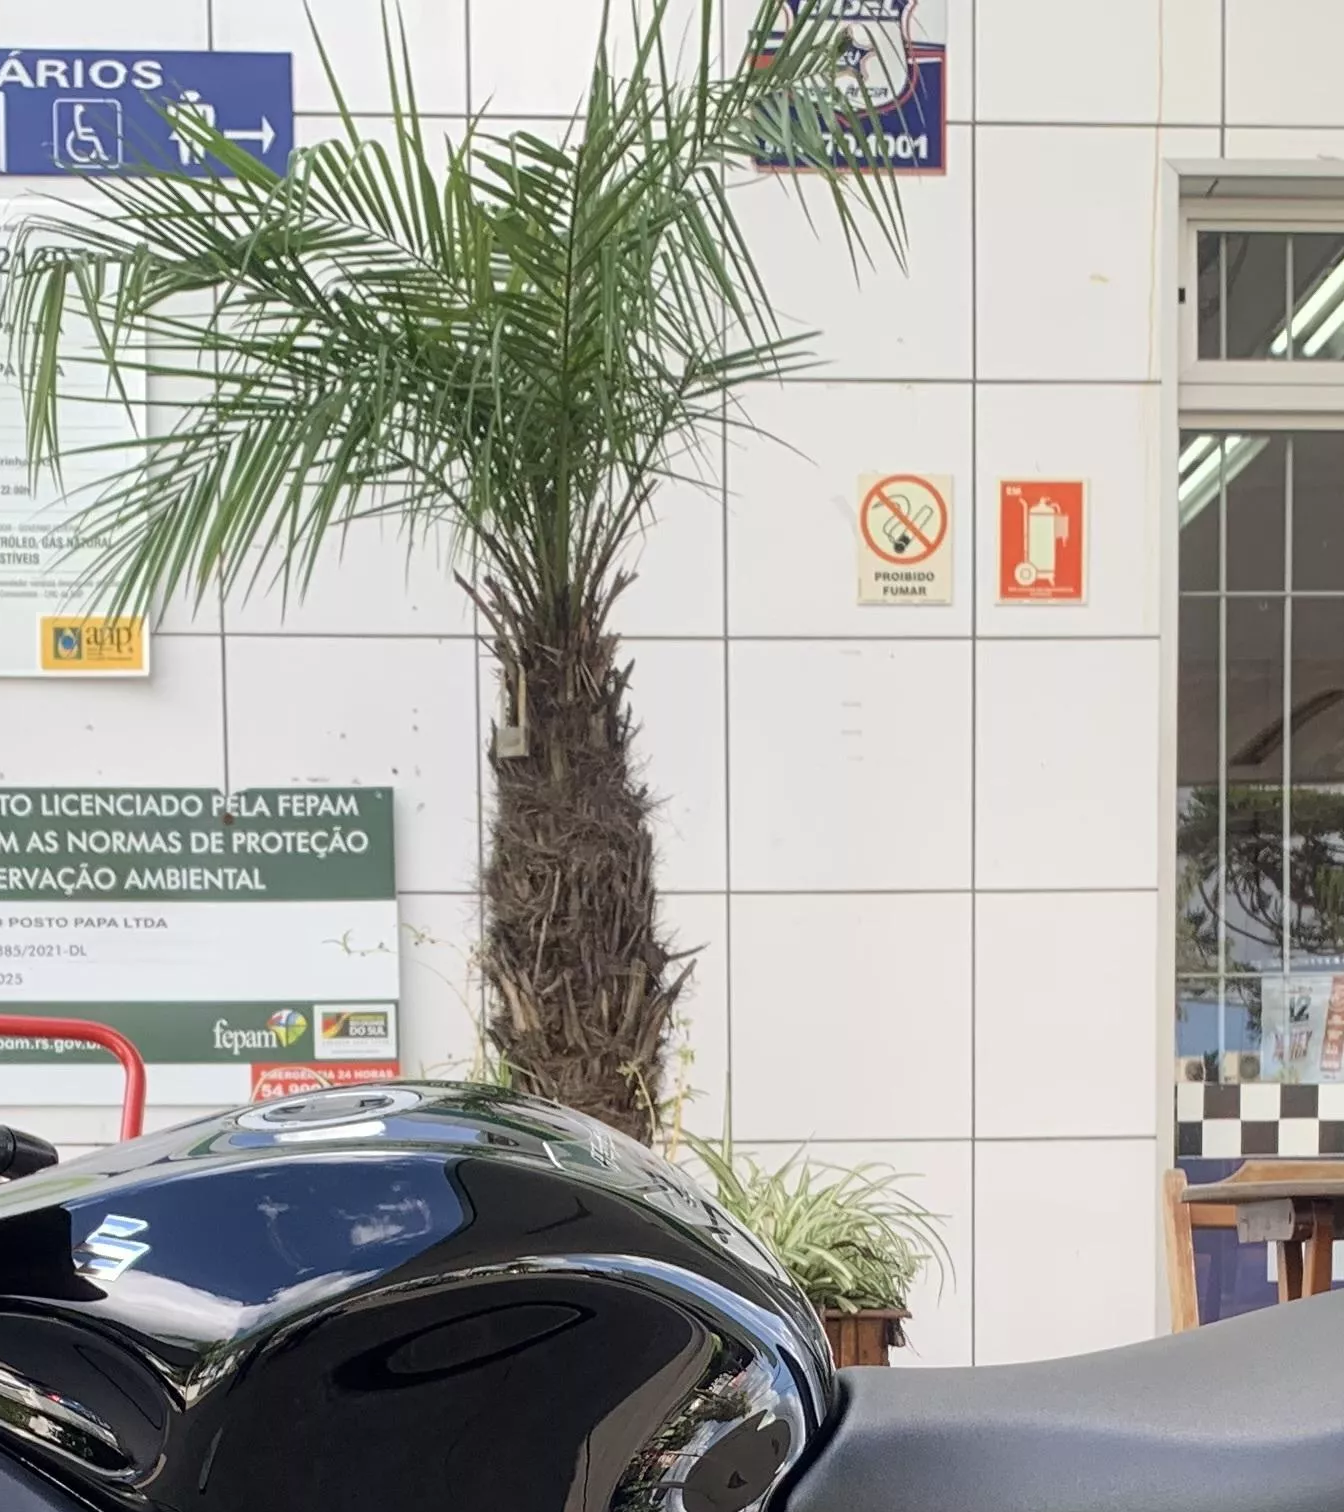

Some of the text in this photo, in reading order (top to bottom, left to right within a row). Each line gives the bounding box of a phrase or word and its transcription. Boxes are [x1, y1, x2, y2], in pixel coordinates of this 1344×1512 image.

[874, 571, 935, 583] PROIBIDO
[882, 586, 927, 597] FUMAR
[40, 794, 204, 818] LICENCIADO
[211, 795, 271, 818] PELA
[277, 795, 360, 817] FEPAM
[25, 830, 58, 853] AS
[67, 831, 182, 854] NORMAS
[190, 832, 225, 854] DE
[232, 825, 369, 859] PROTEÇÃO
[123, 867, 267, 891] AMBIENTAL
[8, 917, 69, 929] POSTO
[74, 917, 119, 930] PAPA
[123, 917, 169, 930] LTDA
[212, 1017, 278, 1056] fepam
